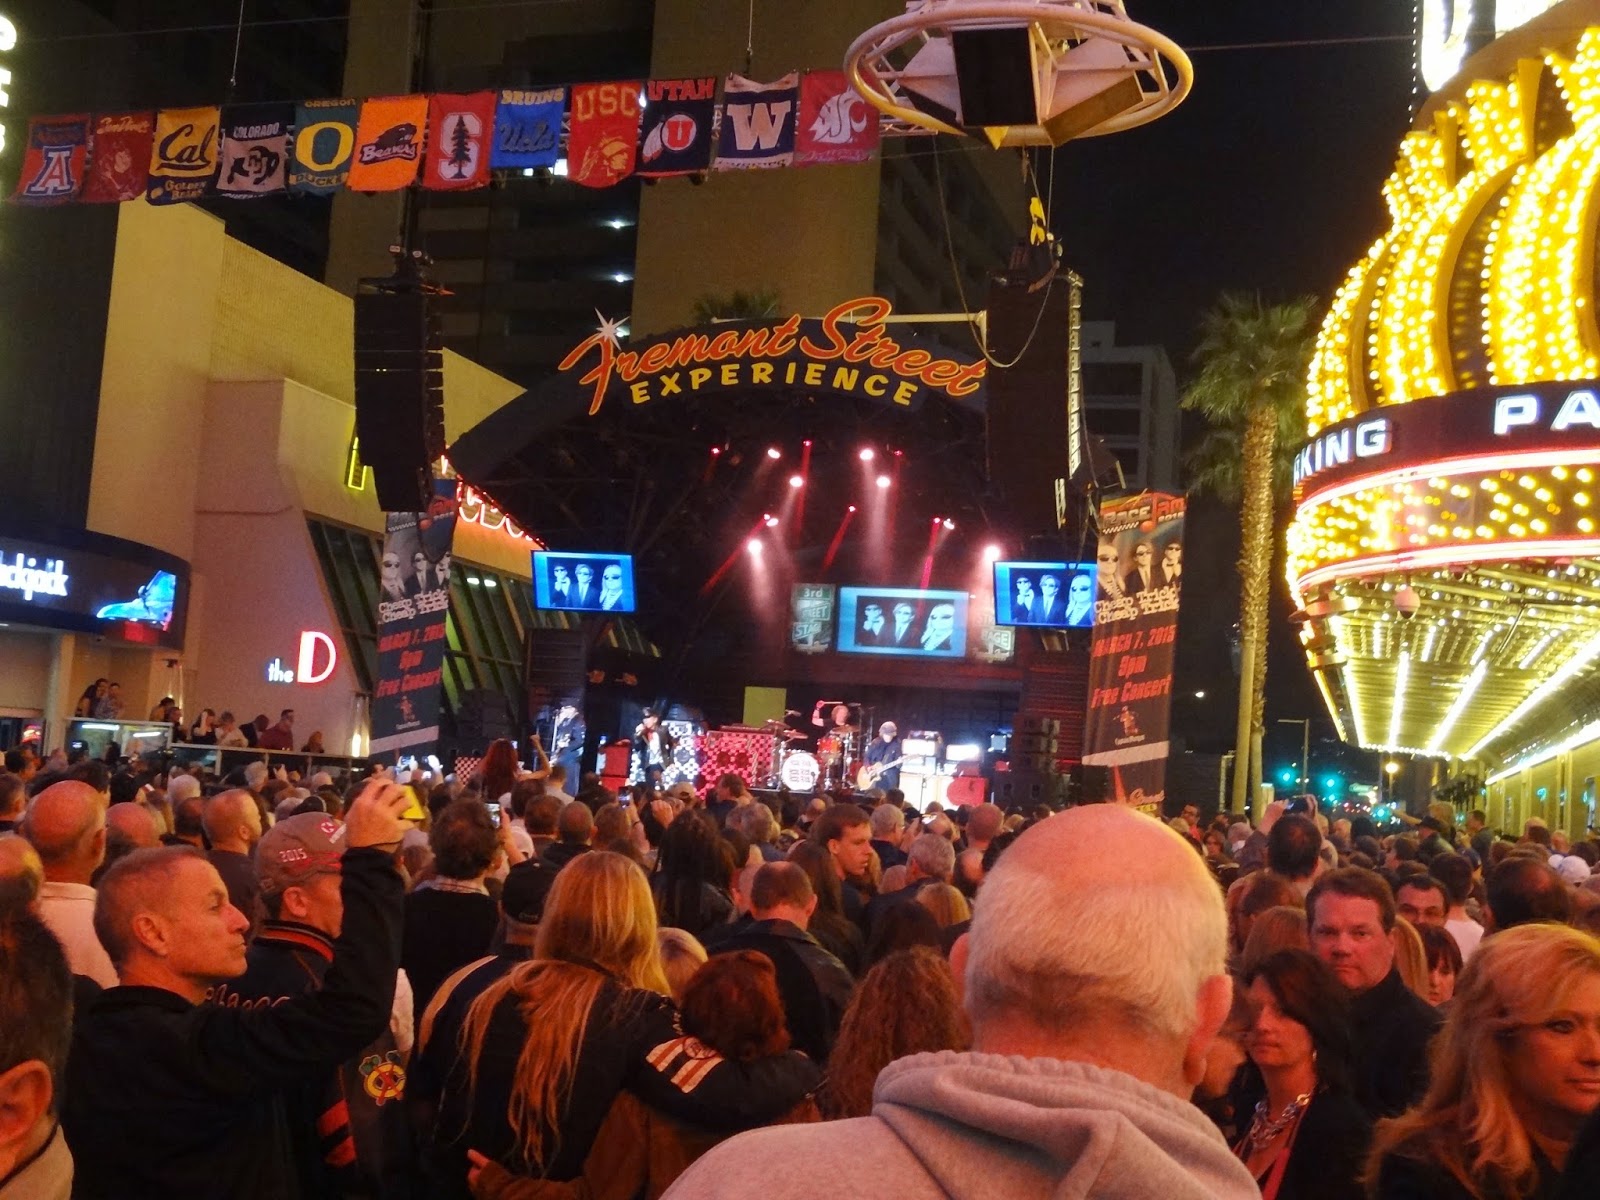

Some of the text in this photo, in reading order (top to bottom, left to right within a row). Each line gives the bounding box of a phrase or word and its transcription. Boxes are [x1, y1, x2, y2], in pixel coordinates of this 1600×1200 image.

[305, 98, 356, 108] OREGON
[501, 88, 564, 106] BRUINS
[576, 84, 638, 120] USC
[647, 78, 716, 101] UTAH
[233, 122, 280, 139] COLORADO
[667, 120, 694, 149] U
[726, 100, 792, 151] W
[158, 123, 216, 171] Cal
[295, 121, 354, 172] O
[361, 142, 417, 162] Beavers
[24, 144, 77, 197] A
[558, 296, 987, 416] Fremont Street
[629, 362, 919, 406] EXPERIENCE
[803, 587, 823, 598] 3rd
[1147, 624, 1176, 647] 2015
[268, 630, 337, 684] the D
[1091, 674, 1172, 709] Free Concert
[279, 847, 308, 862] 2015
